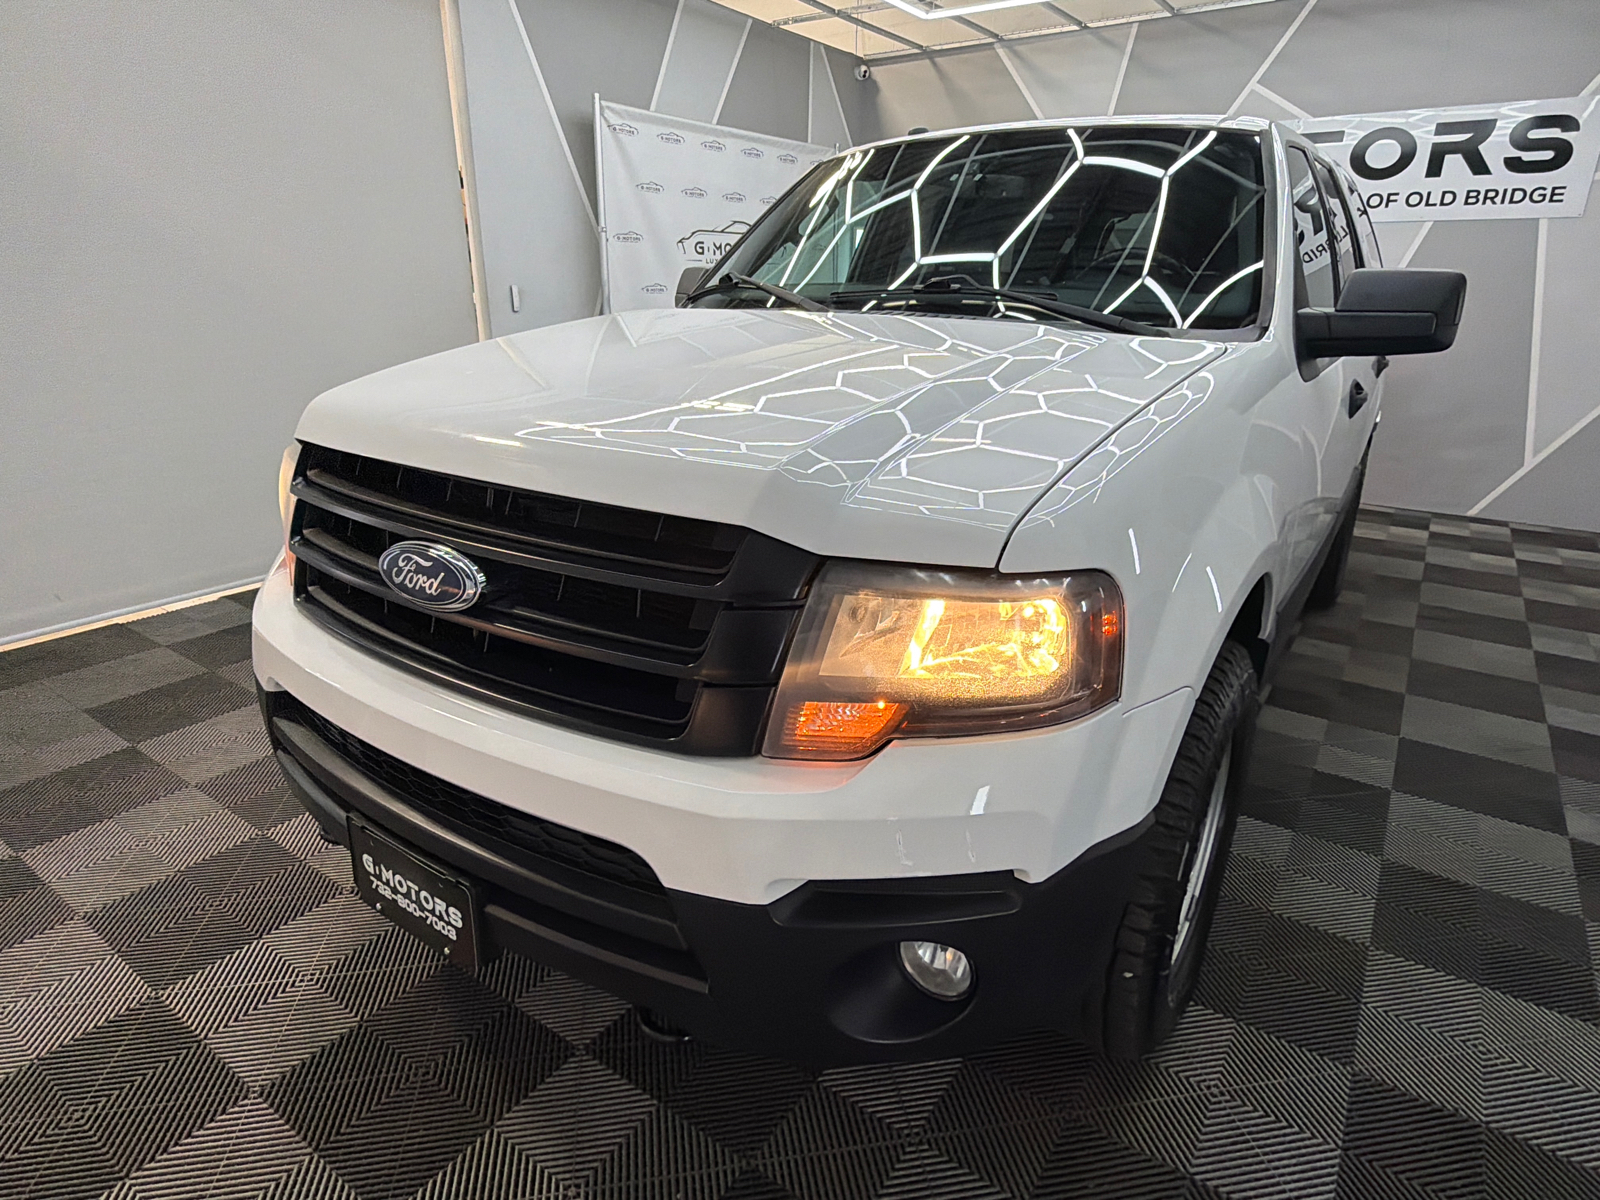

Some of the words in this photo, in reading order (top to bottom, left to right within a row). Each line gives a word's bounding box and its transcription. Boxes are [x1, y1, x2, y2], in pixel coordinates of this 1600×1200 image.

[1366, 192, 1400, 210] OF
[1404, 189, 1457, 208] OLD
[1463, 186, 1567, 206] BRIDGE
[392, 553, 445, 596] Ford
[369, 875, 457, 941] 732-800-7003
